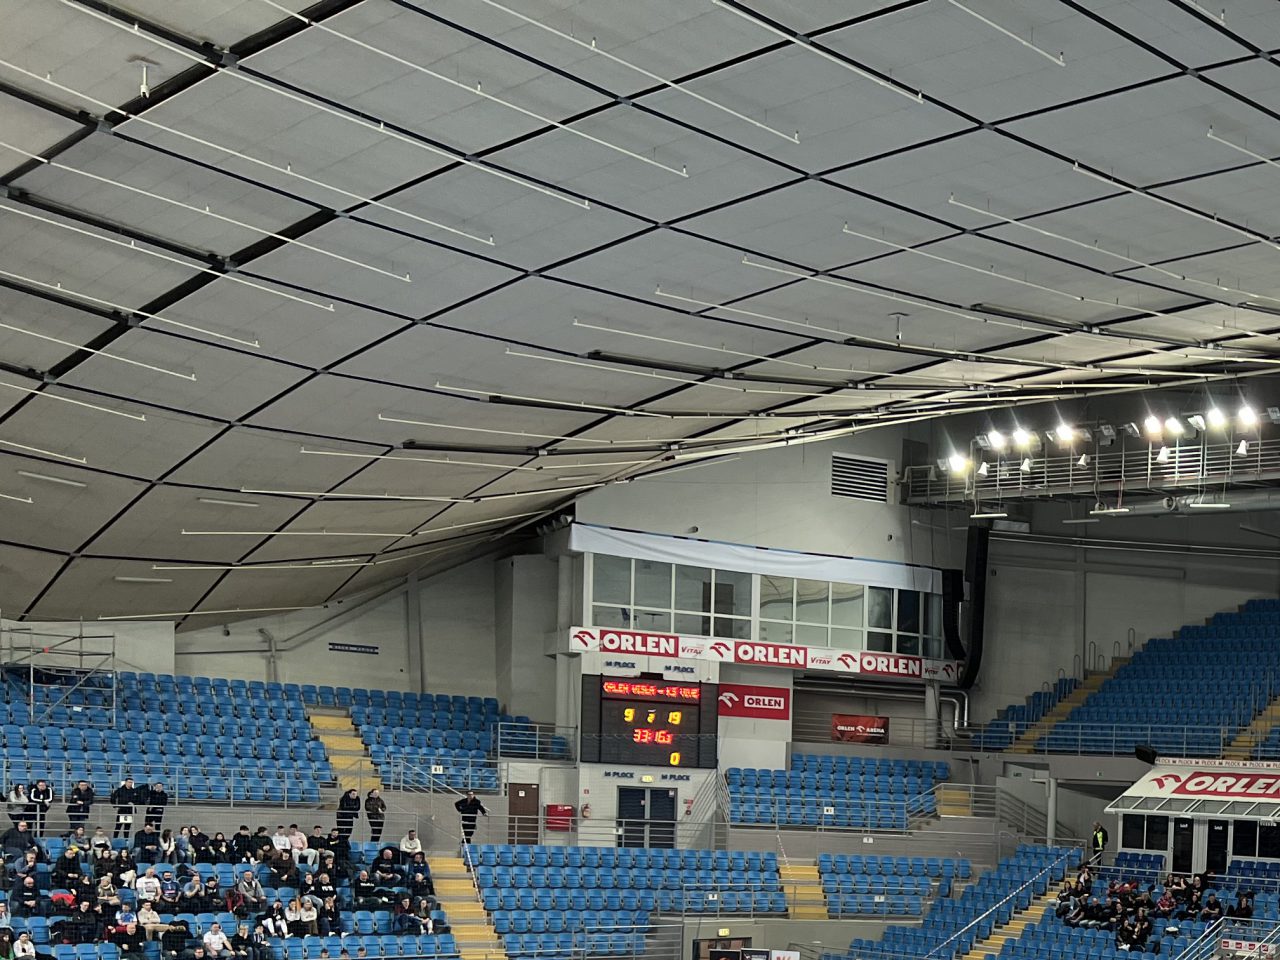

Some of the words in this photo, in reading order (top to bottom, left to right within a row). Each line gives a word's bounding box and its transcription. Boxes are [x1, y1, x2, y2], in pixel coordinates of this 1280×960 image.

[603, 633, 675, 654] ORLEN
[738, 644, 804, 665] ORLEN
[862, 655, 921, 675] ORLEN
[746, 697, 782, 708] ORLEN
[624, 708, 635, 722] 9
[668, 711, 682, 725] 19
[670, 752, 681, 765] 0
